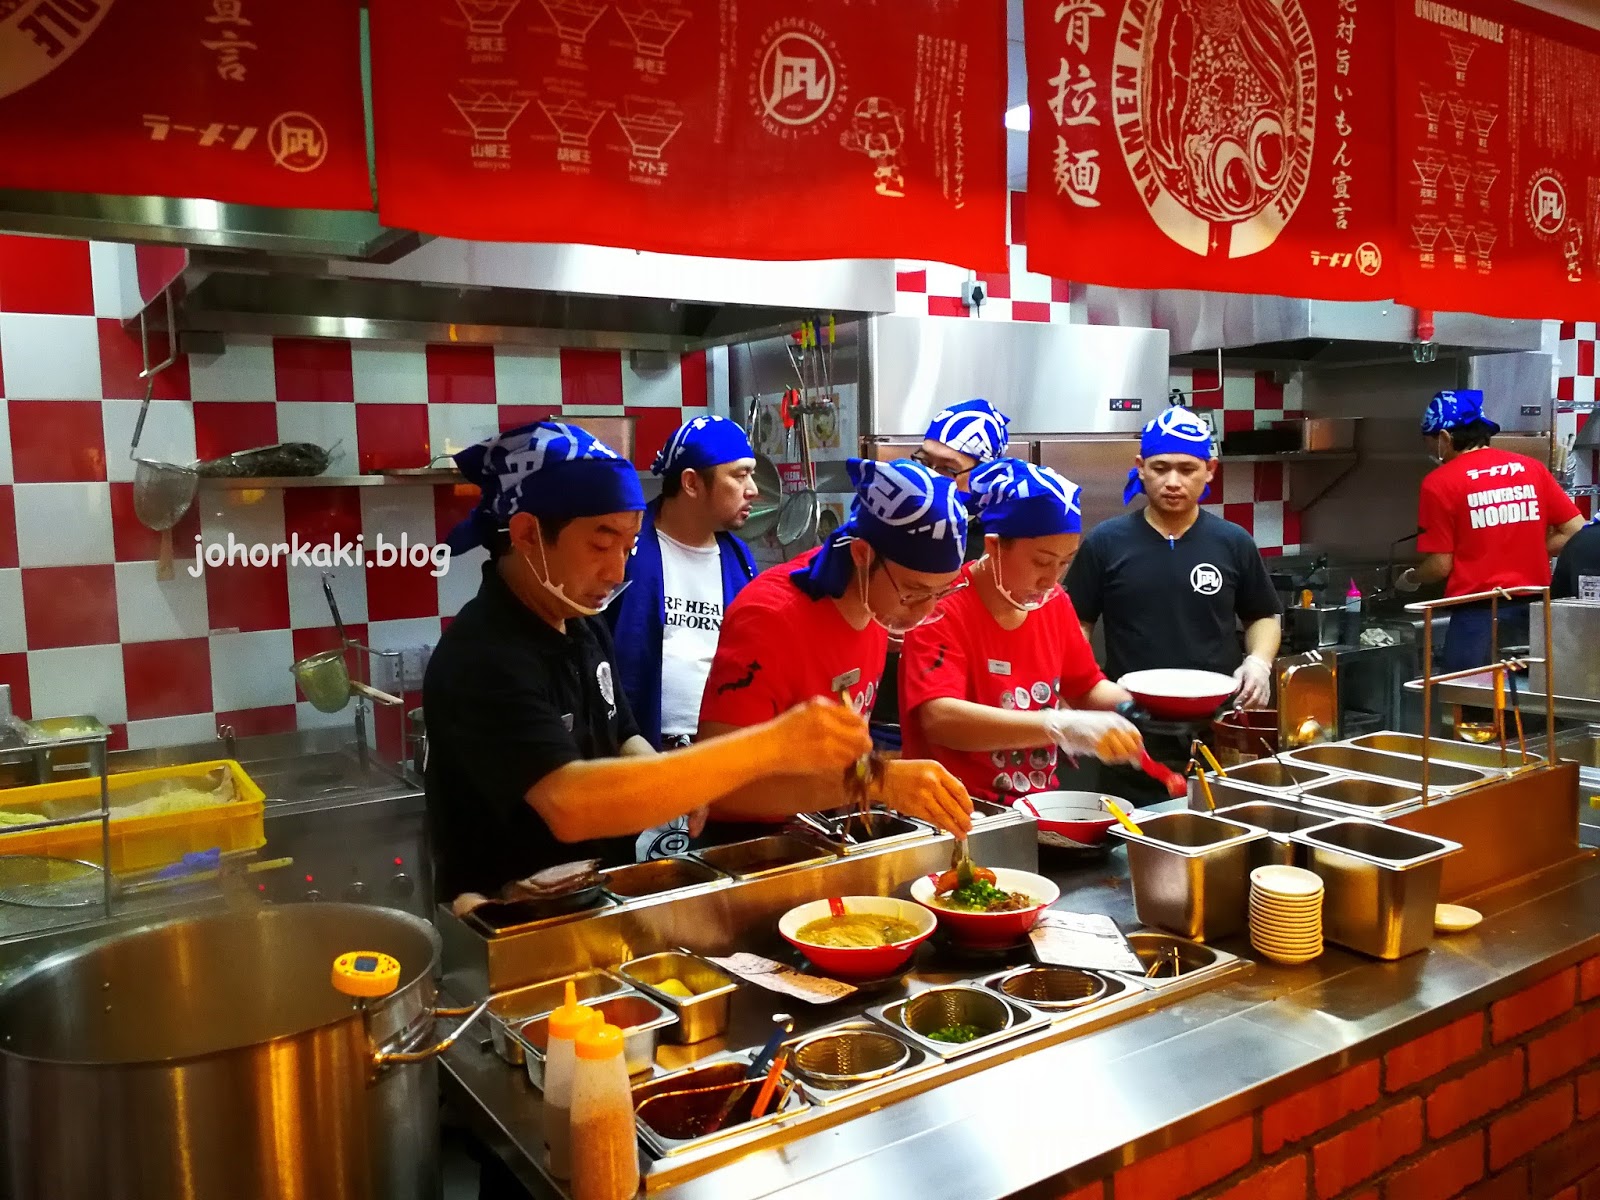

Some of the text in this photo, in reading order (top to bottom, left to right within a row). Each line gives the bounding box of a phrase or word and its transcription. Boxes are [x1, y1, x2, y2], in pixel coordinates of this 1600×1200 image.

[1415, 0, 1468, 32] UNIVERSAL
[1469, 14, 1504, 43] NOODLE
[142, 114, 258, 151] ラーメン
[1115, 64, 1160, 207] RAMEN
[1274, 134, 1312, 221] NOODLE
[1311, 251, 1352, 268] ラーメン
[1467, 484, 1537, 507] UNIVERSAL
[1470, 500, 1540, 529] NOODLE
[685, 600, 720, 616] HEA
